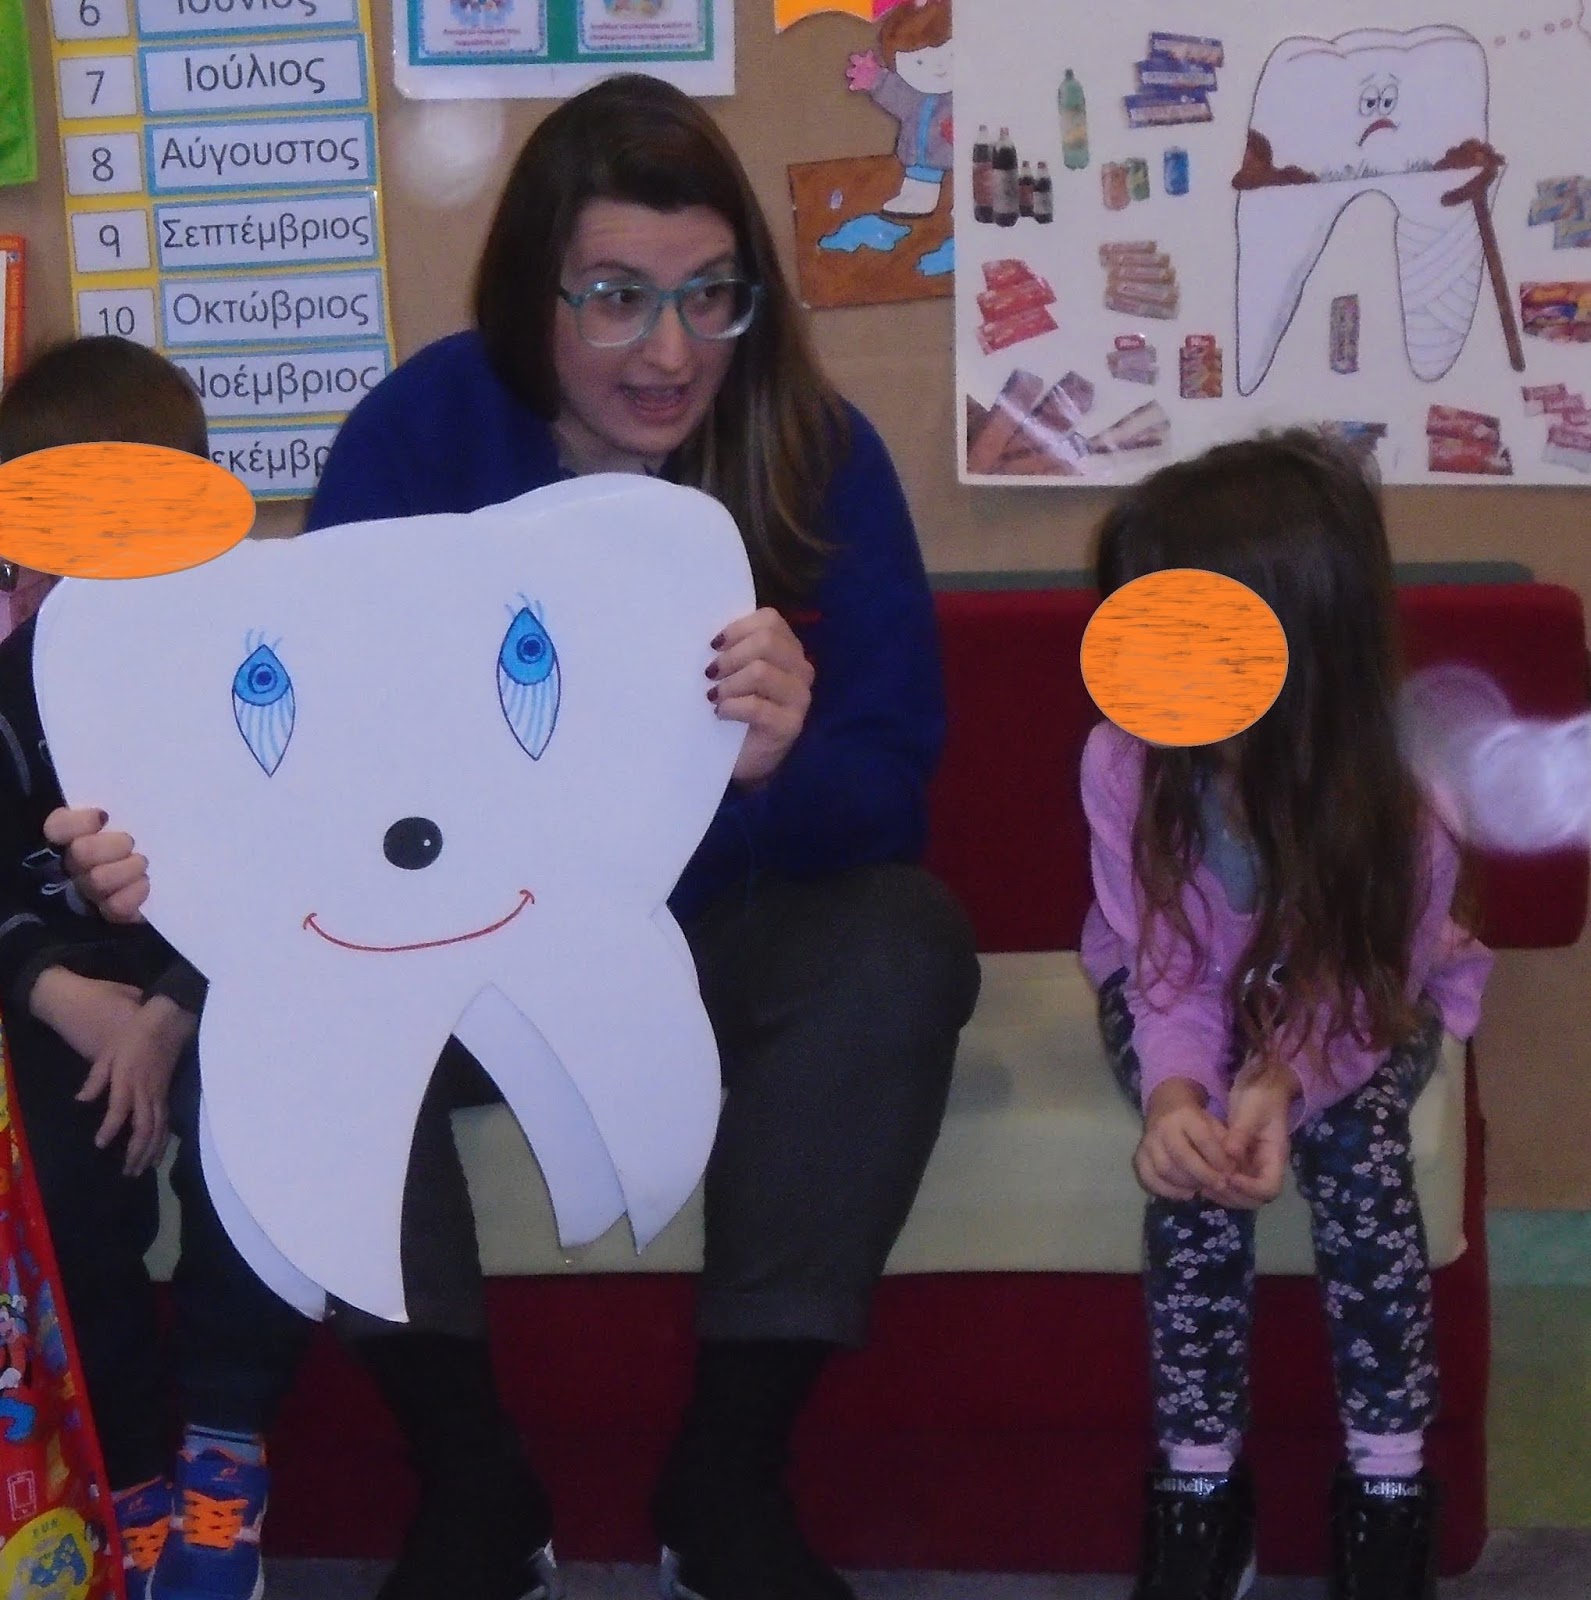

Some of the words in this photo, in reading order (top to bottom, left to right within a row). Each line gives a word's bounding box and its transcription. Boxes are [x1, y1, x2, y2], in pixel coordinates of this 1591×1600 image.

[80, 0, 101, 26] 6
[85, 70, 105, 105] 7
[184, 54, 326, 94] Ιούλιος
[91, 147, 114, 182] 8
[160, 136, 360, 175] Αύγουστος
[98, 224, 121, 258] 9
[162, 212, 370, 250] Σεπτέμβριος
[98, 306, 135, 336] 10
[173, 289, 369, 329] Οκτώβριος
